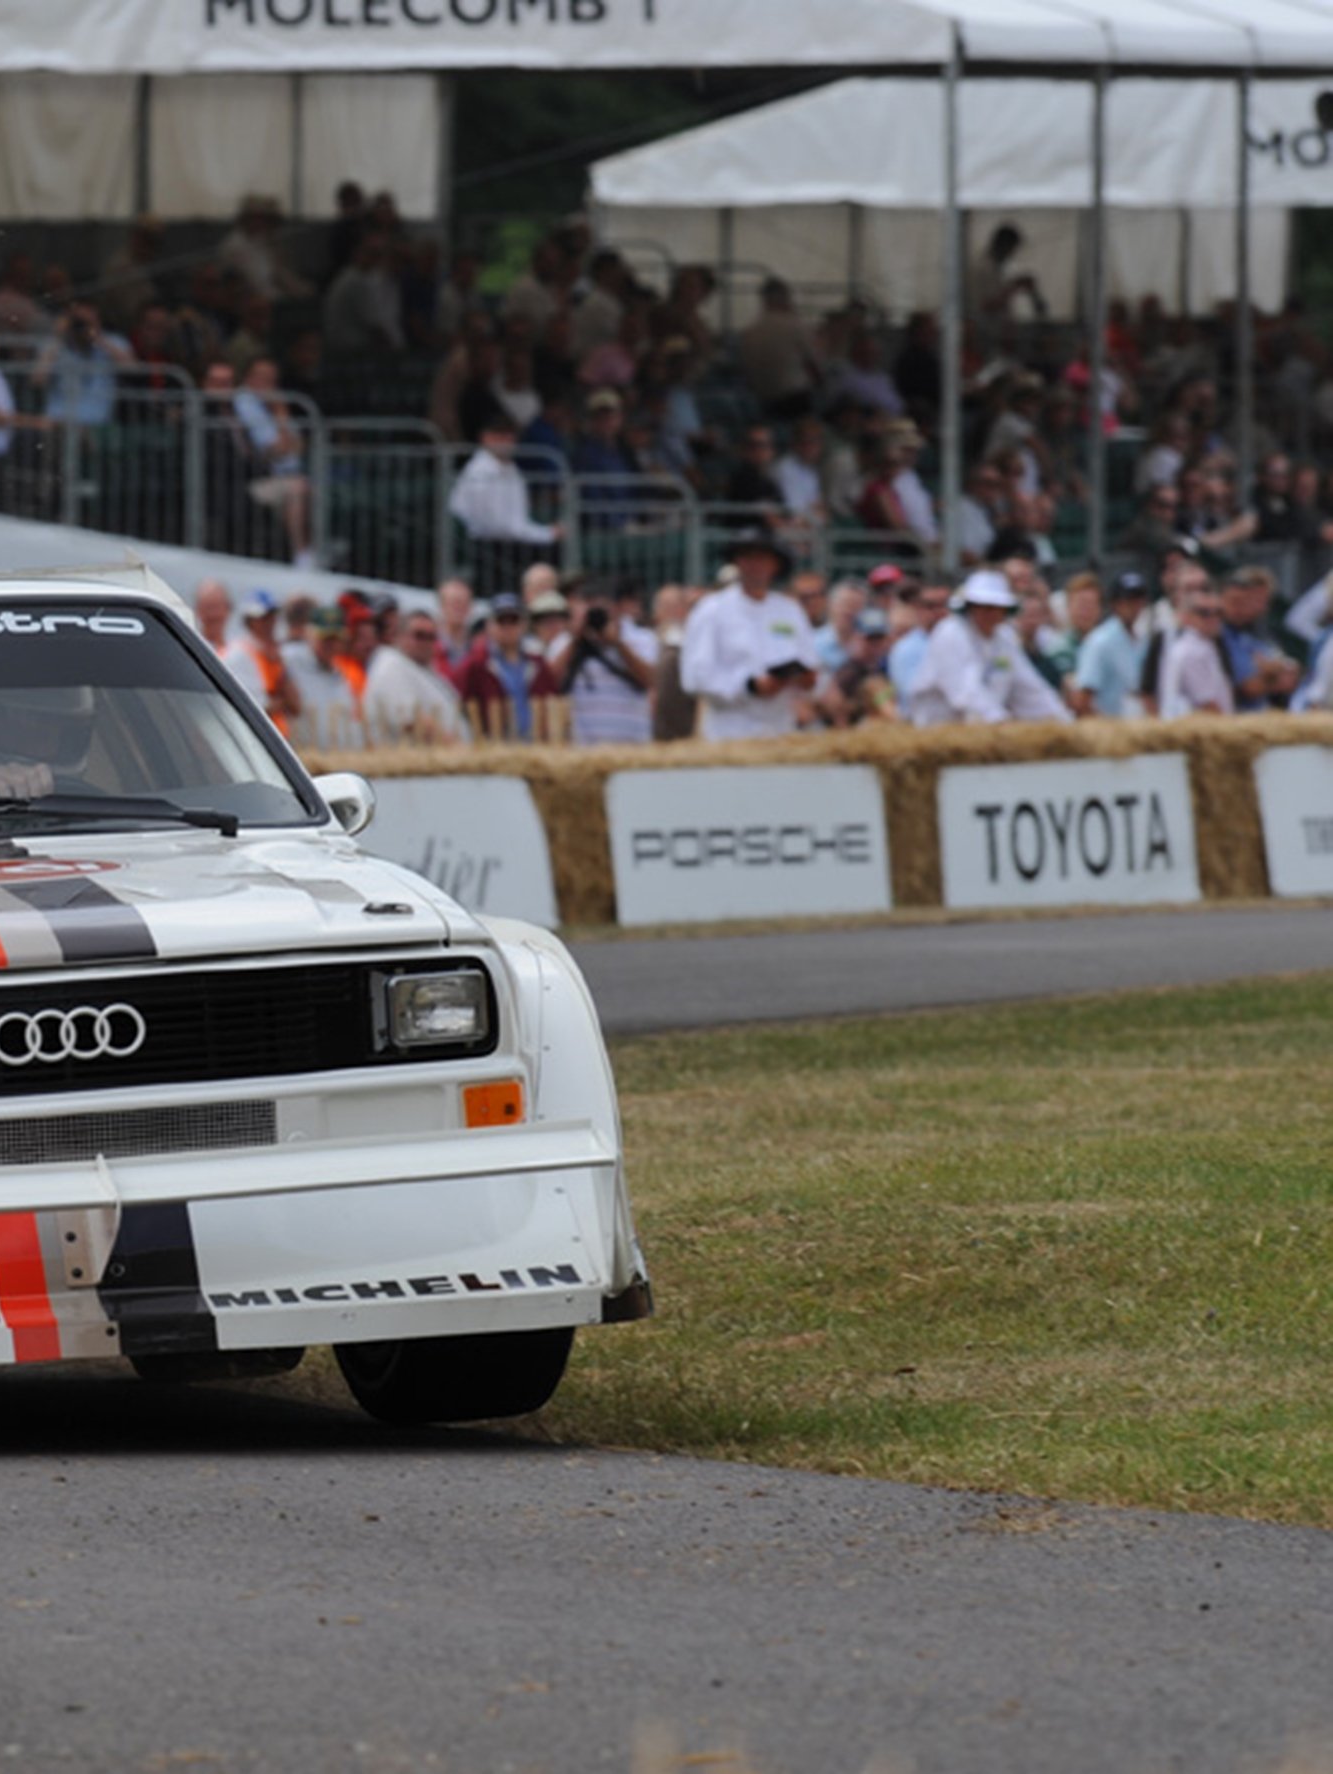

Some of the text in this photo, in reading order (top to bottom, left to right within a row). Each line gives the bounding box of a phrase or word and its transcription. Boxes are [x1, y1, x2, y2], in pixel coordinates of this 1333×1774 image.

[632, 822, 871, 871] PORSCHE
[973, 793, 1174, 883] TOYOTA
[208, 1263, 583, 1309] MICHELIN
